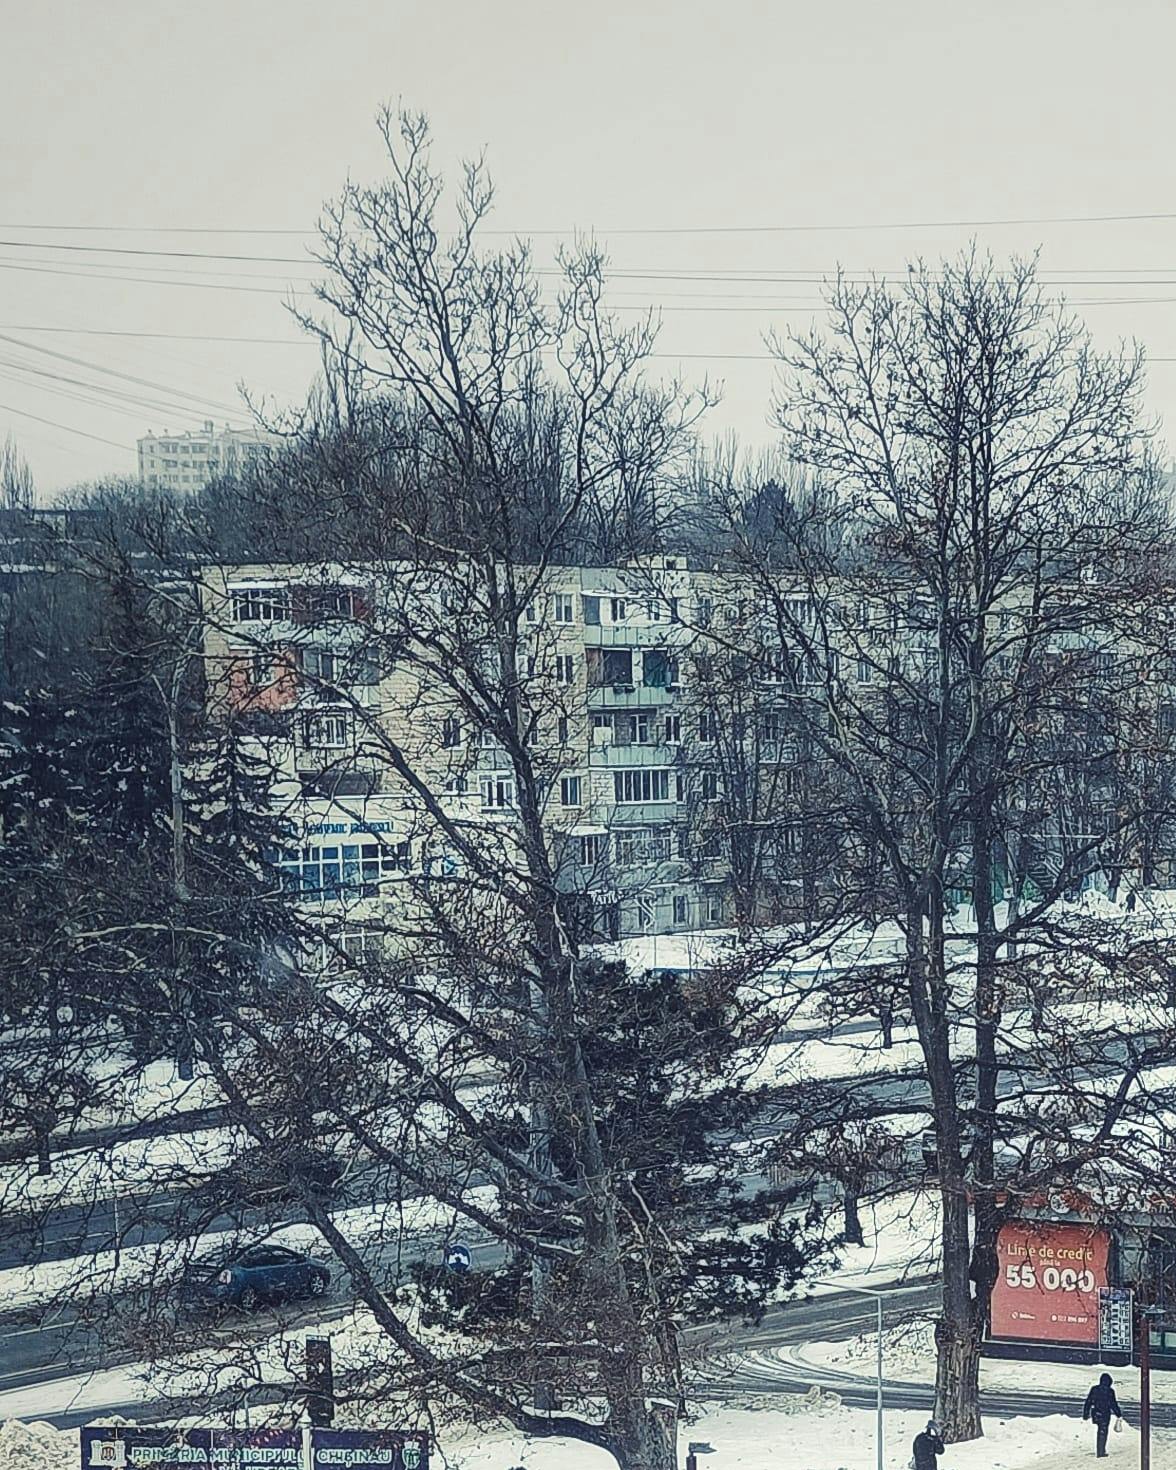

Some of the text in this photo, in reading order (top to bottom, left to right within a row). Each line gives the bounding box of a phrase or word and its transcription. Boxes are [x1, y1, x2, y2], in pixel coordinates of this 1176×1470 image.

[1039, 1246, 1054, 1258] de
[1006, 1264, 1095, 1293] 55 000
[131, 1445, 208, 1463] PRIRIA
[210, 1446, 314, 1463] MUICIPIUL
